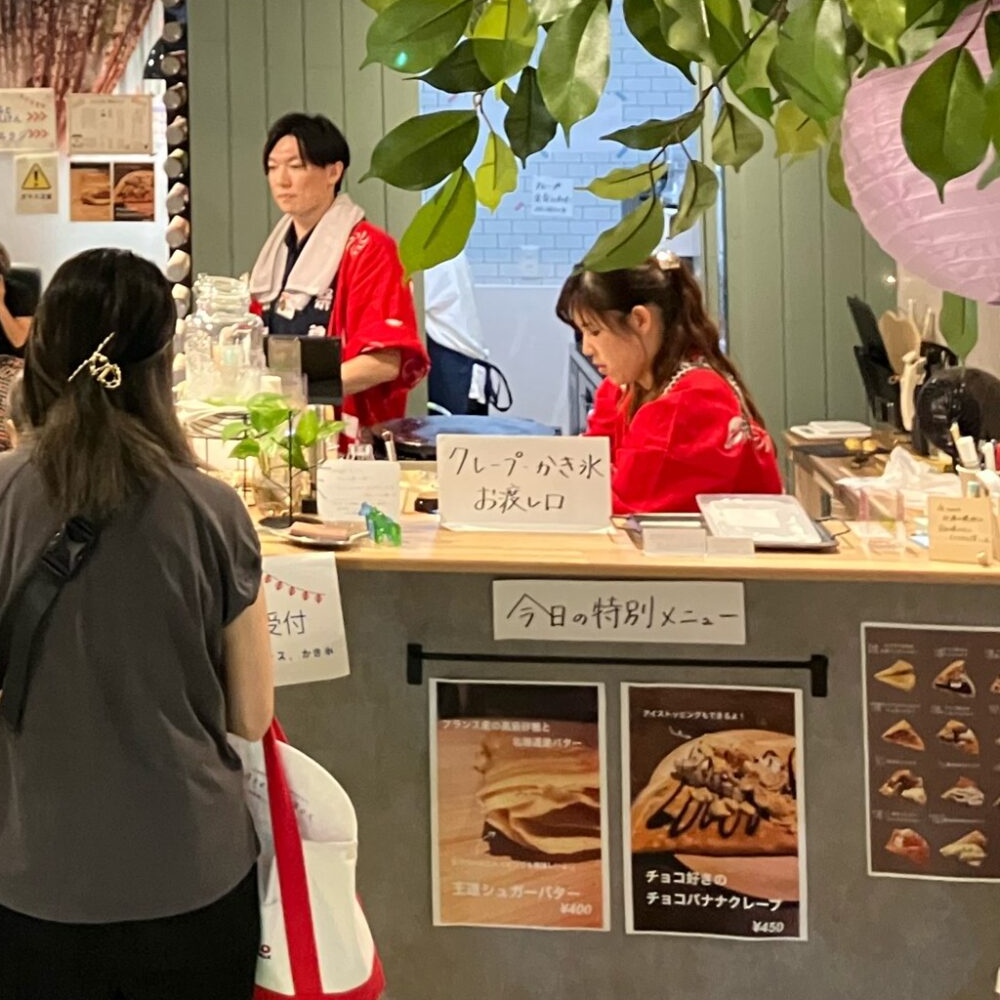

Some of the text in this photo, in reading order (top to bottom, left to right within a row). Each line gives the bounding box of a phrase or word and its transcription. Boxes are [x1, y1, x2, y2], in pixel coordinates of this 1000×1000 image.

[473, 484, 566, 514] お渡し口
[506, 593, 739, 629] 今日の特別メニュー
[646, 870, 728, 886] チョコ好きの
[452, 881, 581, 899] 王道シュガーバター
[560, 902, 593, 915] ¥400
[646, 891, 783, 912] チョコバナナクレープ
[752, 920, 785, 933] ¥450
